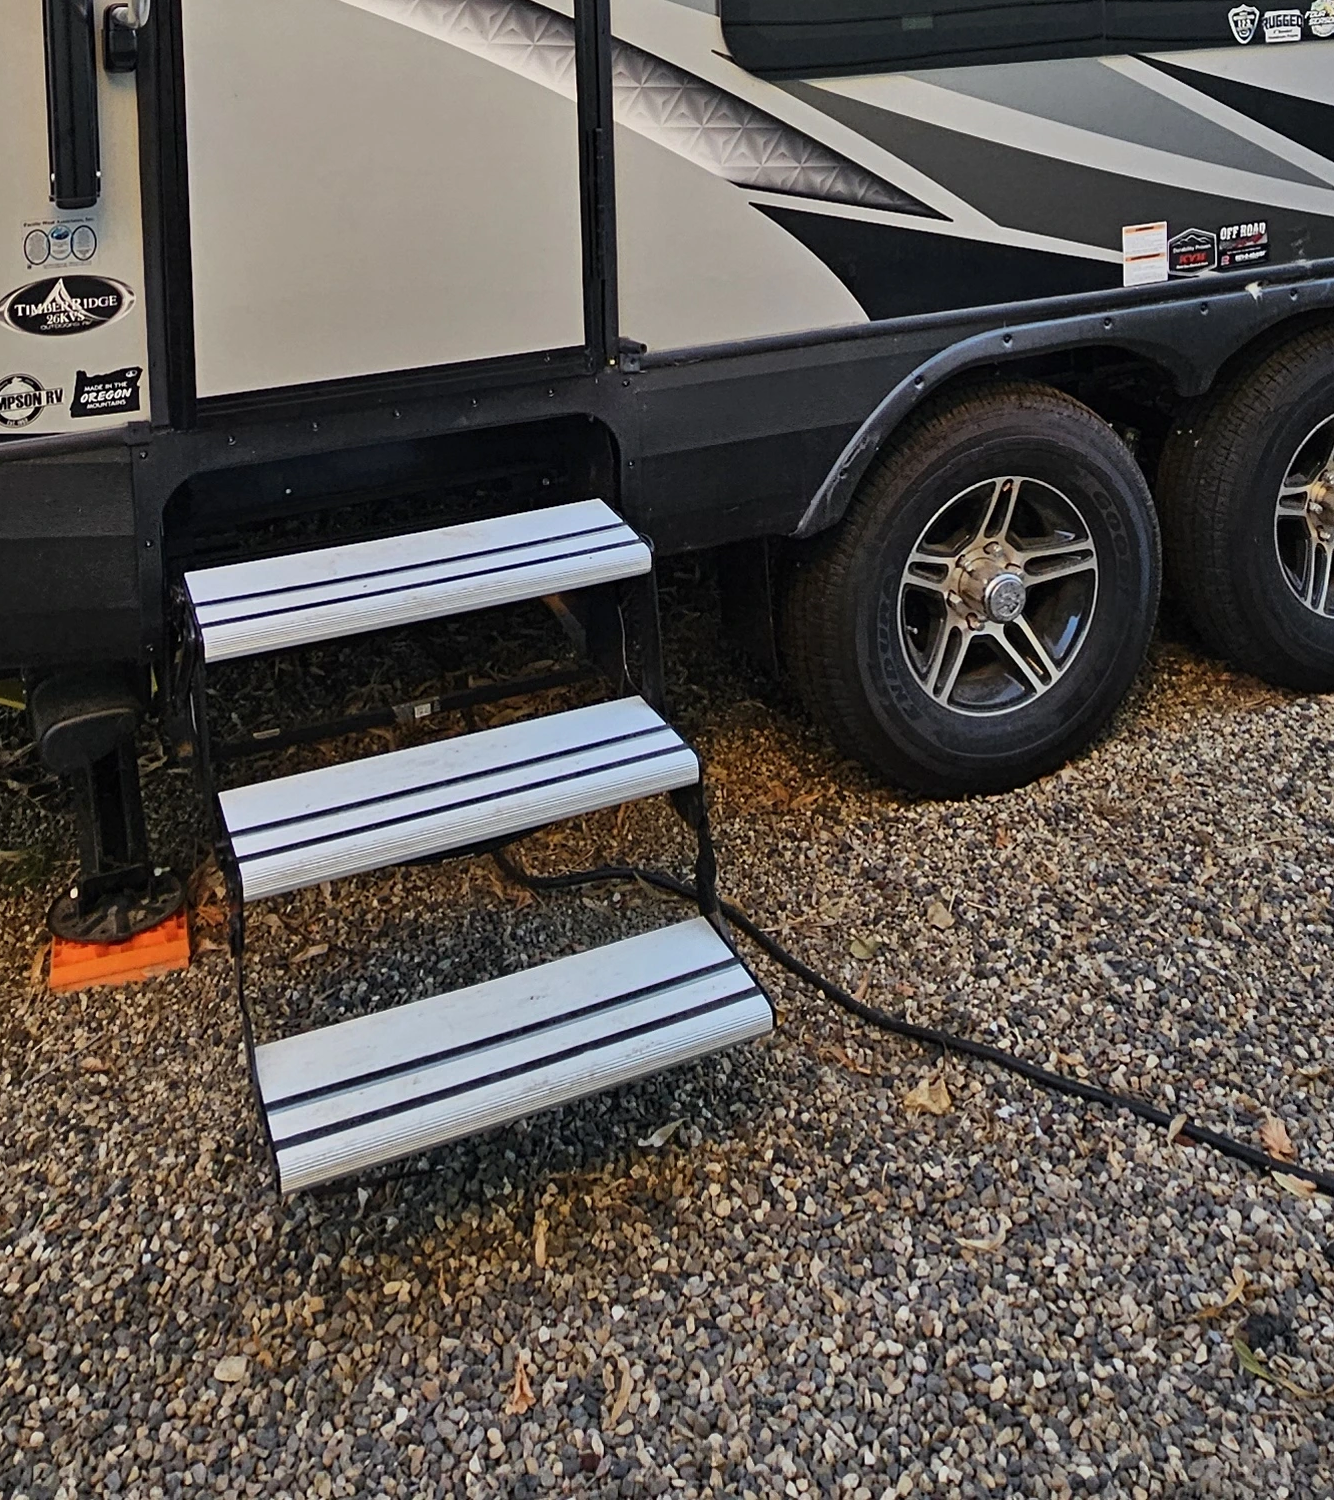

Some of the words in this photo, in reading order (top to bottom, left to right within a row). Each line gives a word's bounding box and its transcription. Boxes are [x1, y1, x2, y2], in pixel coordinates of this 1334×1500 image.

[1261, 14, 1304, 30] RUGGED
[1219, 226, 1239, 241] OFF
[46, 311, 86, 325] 26KVS
[84, 384, 104, 392] MADE
[104, 382, 113, 390] IN
[114, 380, 128, 389] THE
[46, 388, 64, 405] RV
[79, 387, 133, 404] OREGON
[86, 399, 127, 410] MOUNTAINS
